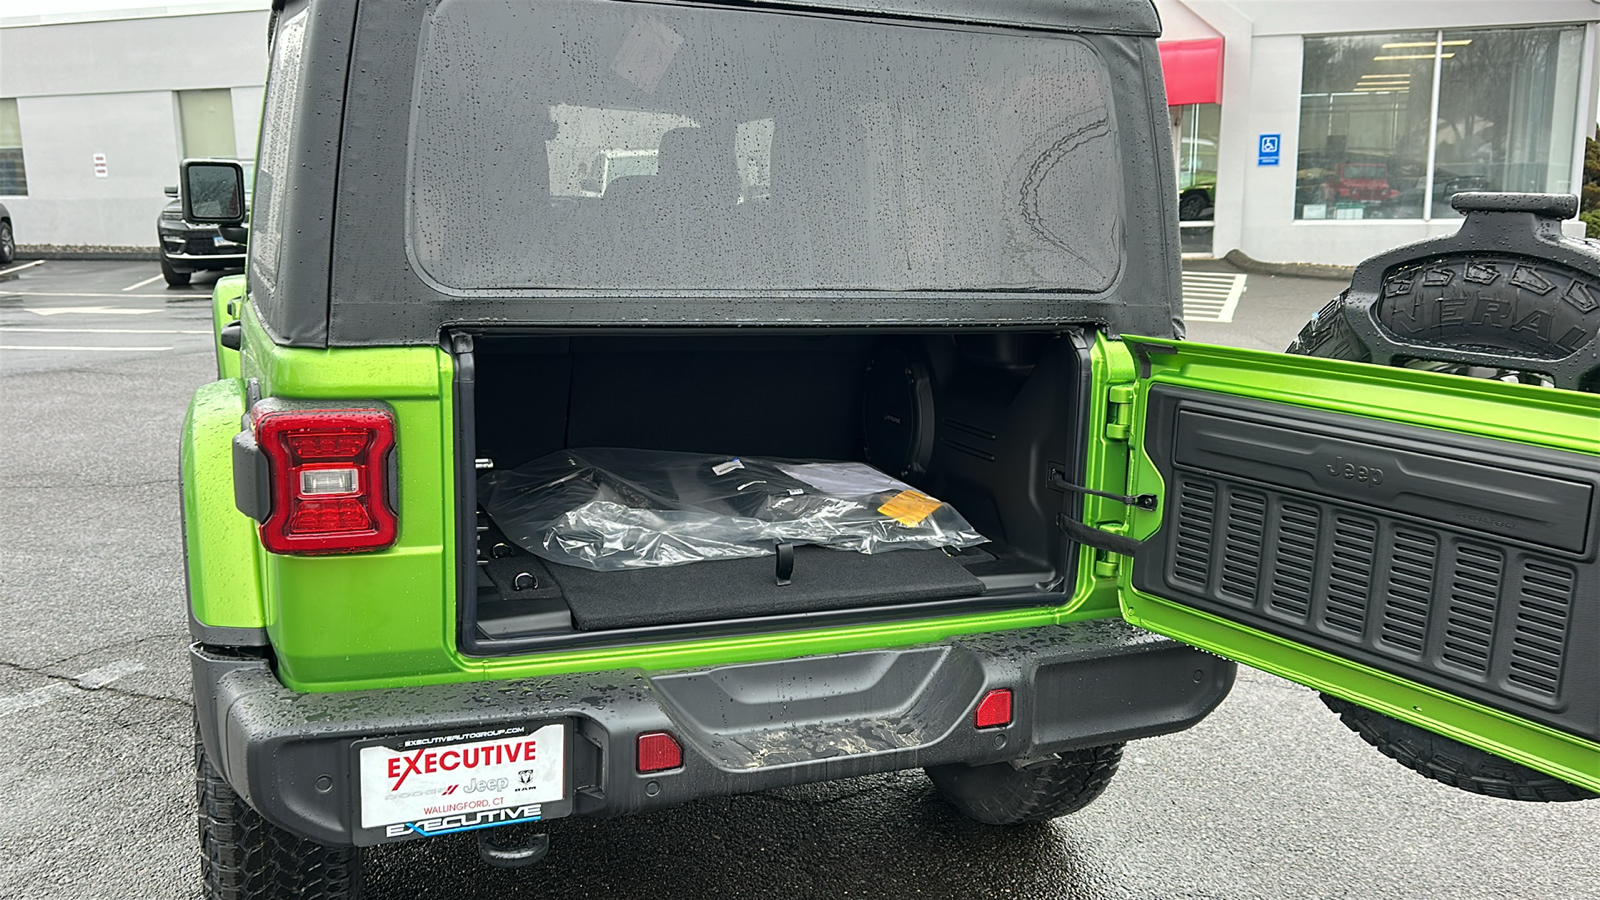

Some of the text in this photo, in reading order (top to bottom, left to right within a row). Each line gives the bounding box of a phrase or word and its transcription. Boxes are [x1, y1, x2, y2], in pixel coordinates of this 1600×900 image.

[1326, 455, 1384, 488] Jeep
[404, 726, 525, 747] EXECUTIVEAUTOGROUP.COM
[387, 741, 536, 791] EXECUTIVE
[463, 777, 509, 794] Jeep
[423, 796, 504, 815] WALLINGFORD, CT
[386, 803, 542, 837] EXECUTIVE
